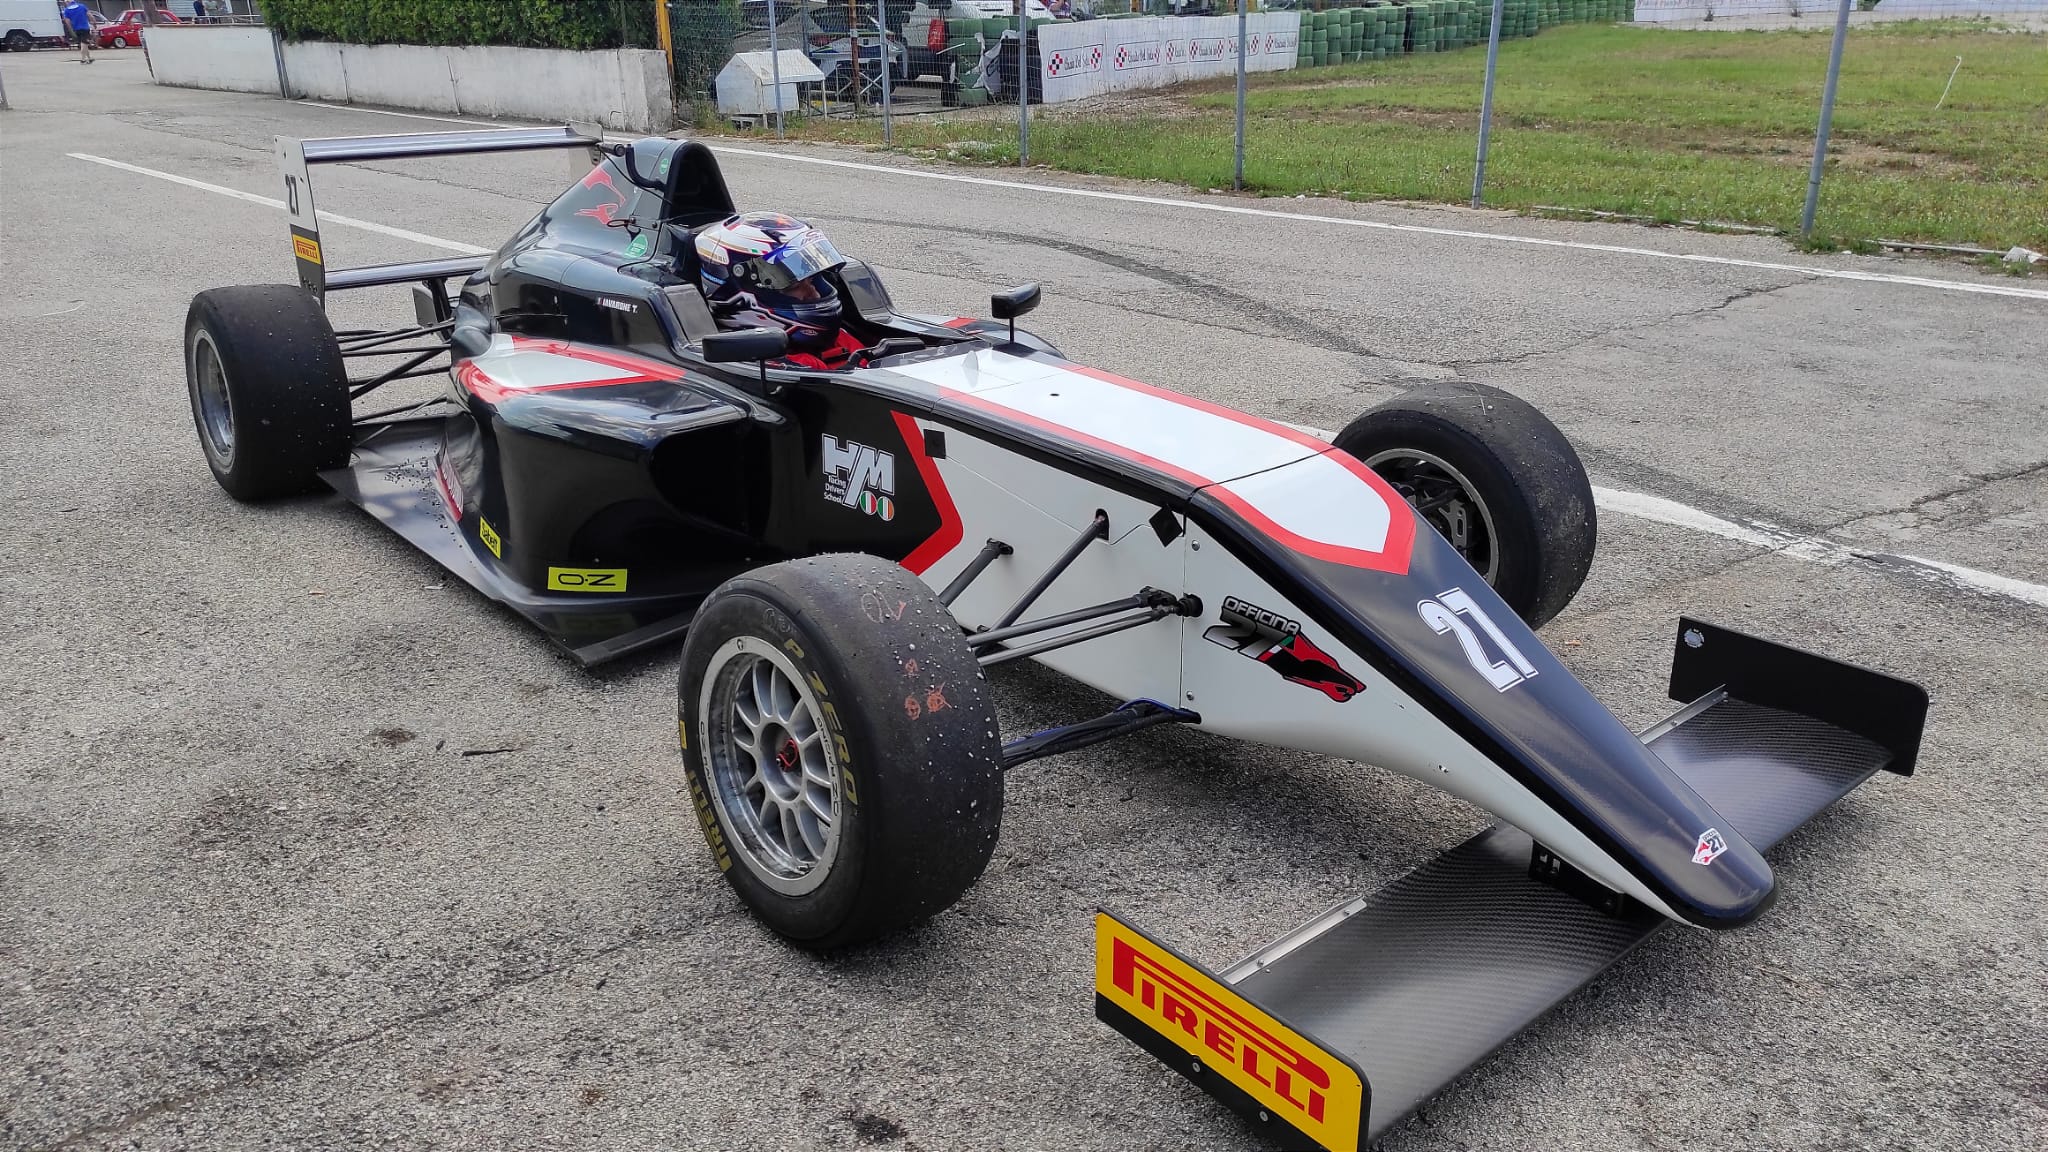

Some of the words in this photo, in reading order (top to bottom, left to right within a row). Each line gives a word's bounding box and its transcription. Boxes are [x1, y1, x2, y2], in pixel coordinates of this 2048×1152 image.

[295, 239, 319, 260] PIRELLI
[1224, 597, 1300, 635] OFFICINA
[1416, 587, 1540, 693] 27
[806, 670, 859, 806] ZERO
[686, 769, 734, 873] PIRELLI
[1112, 936, 1331, 1125] PIRELLI
